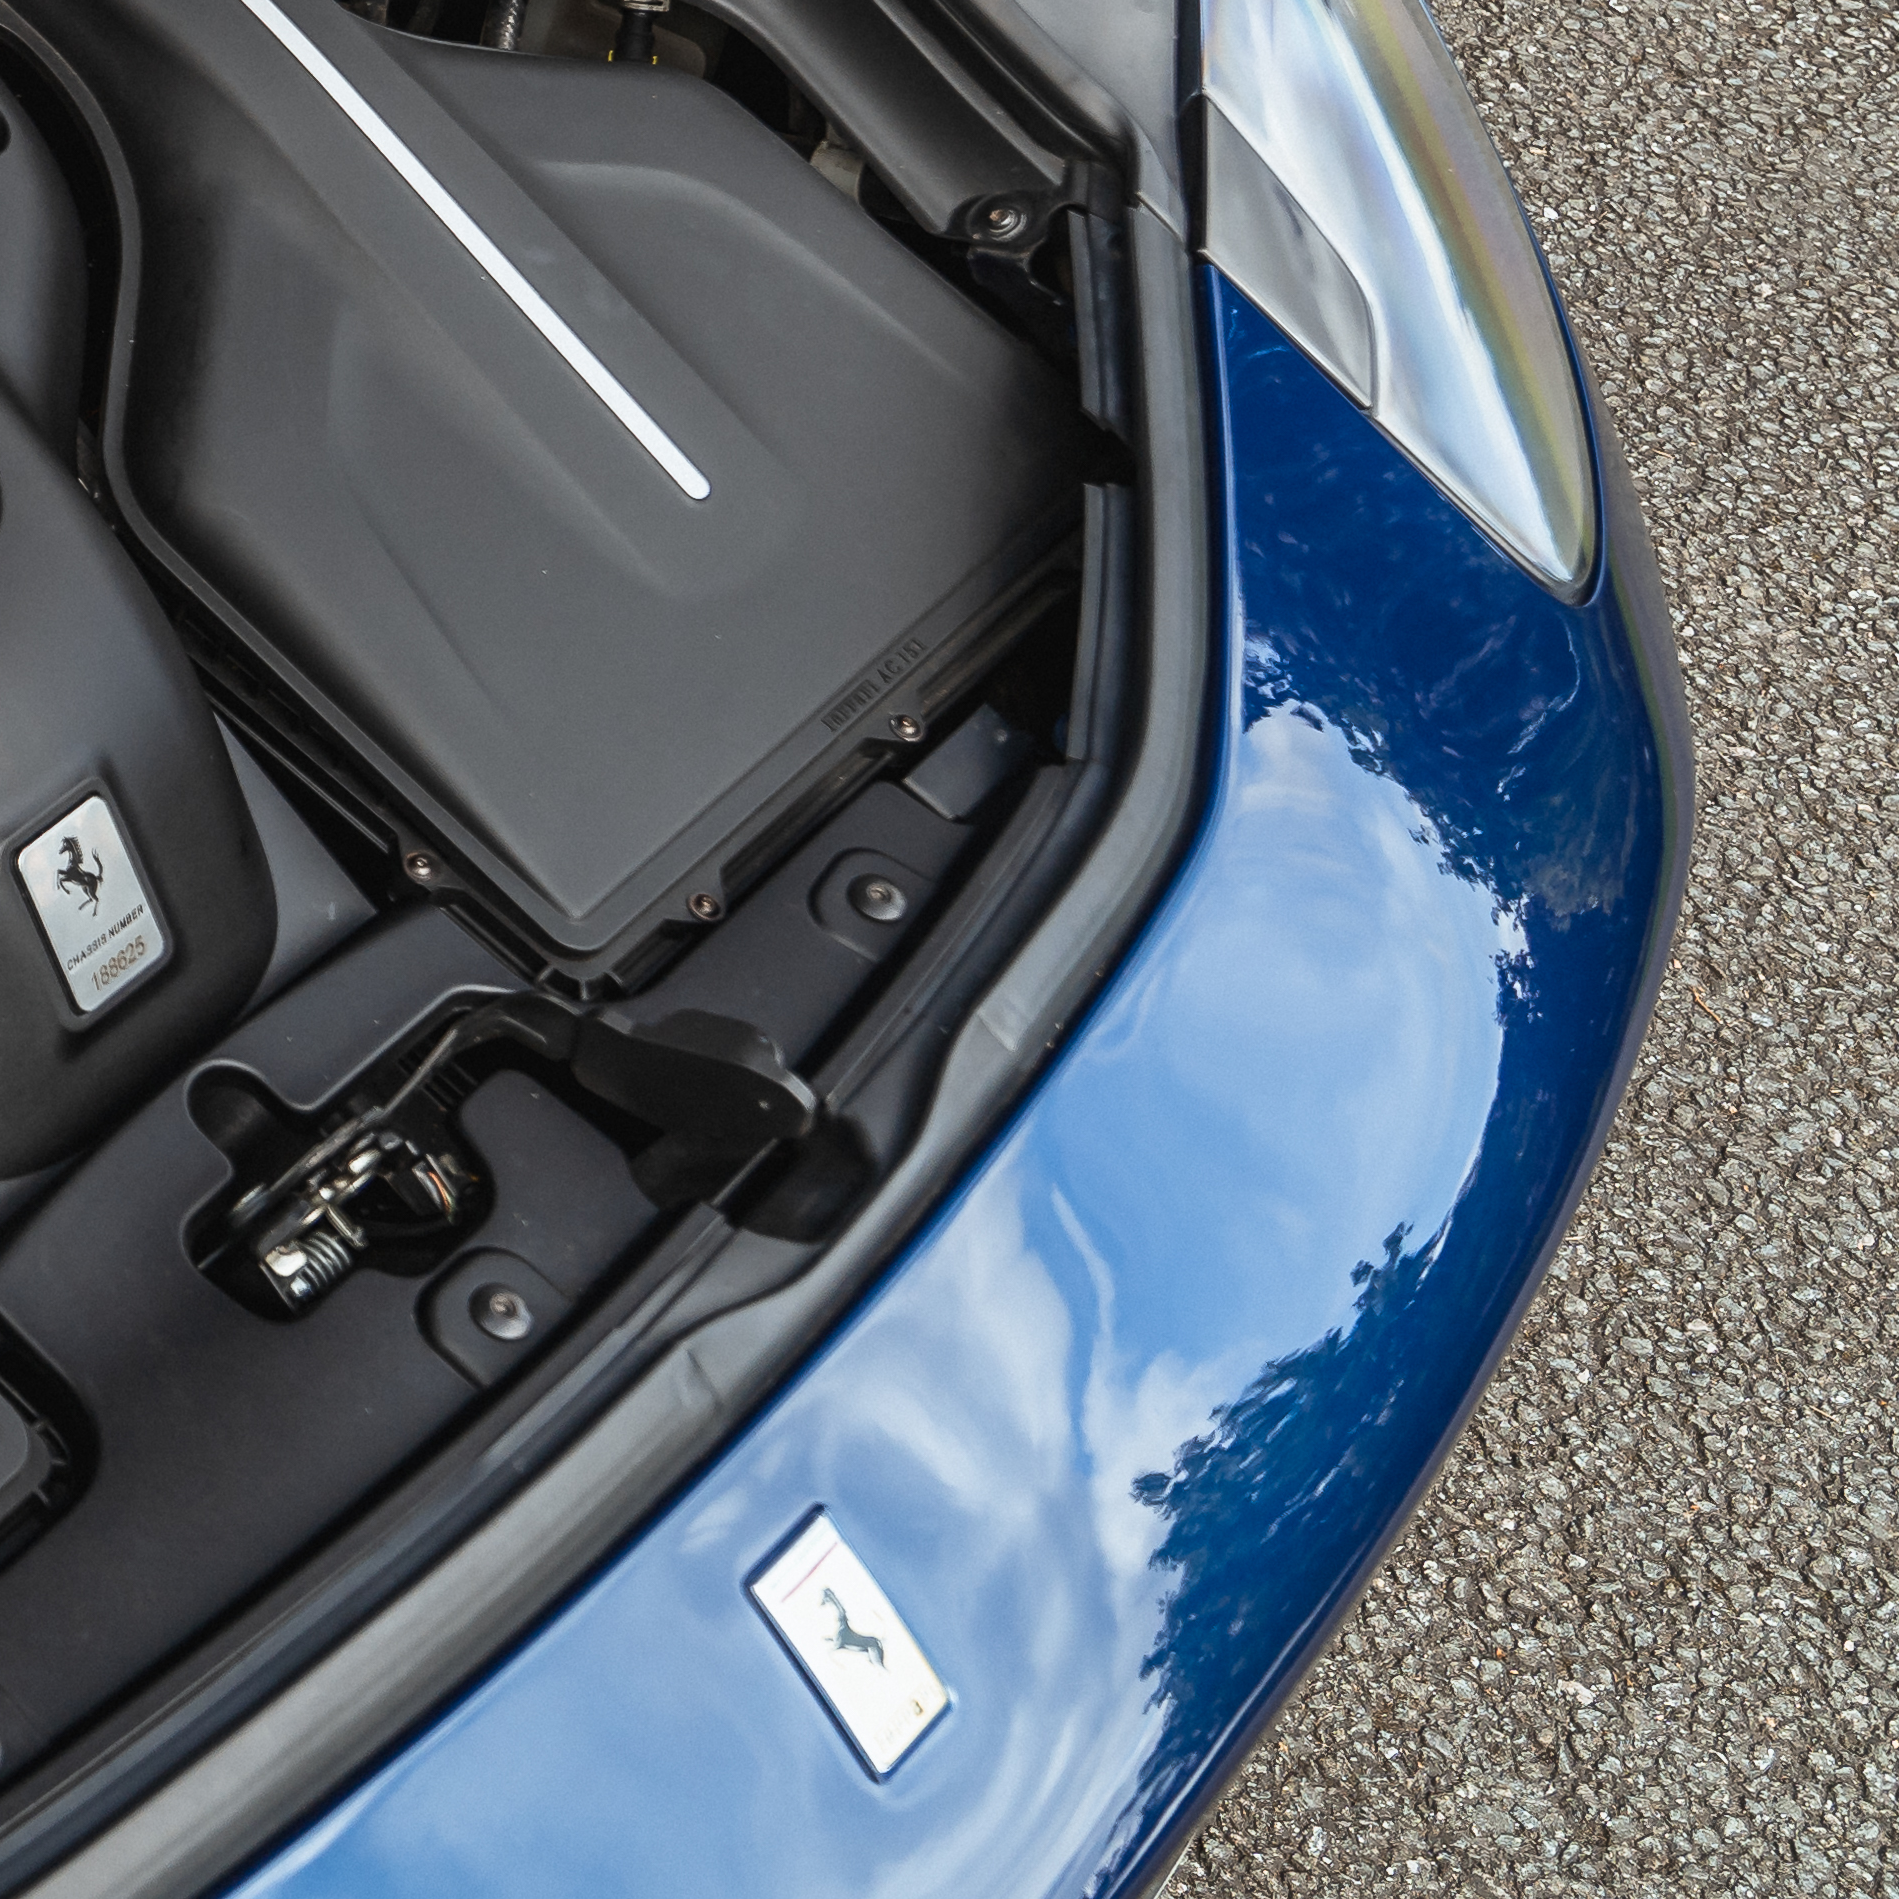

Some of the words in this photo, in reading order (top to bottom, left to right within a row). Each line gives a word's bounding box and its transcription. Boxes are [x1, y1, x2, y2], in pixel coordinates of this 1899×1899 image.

[66, 933, 108, 971] CHASSIS
[107, 903, 144, 939] NUMBER
[91, 934, 147, 991] 188625
